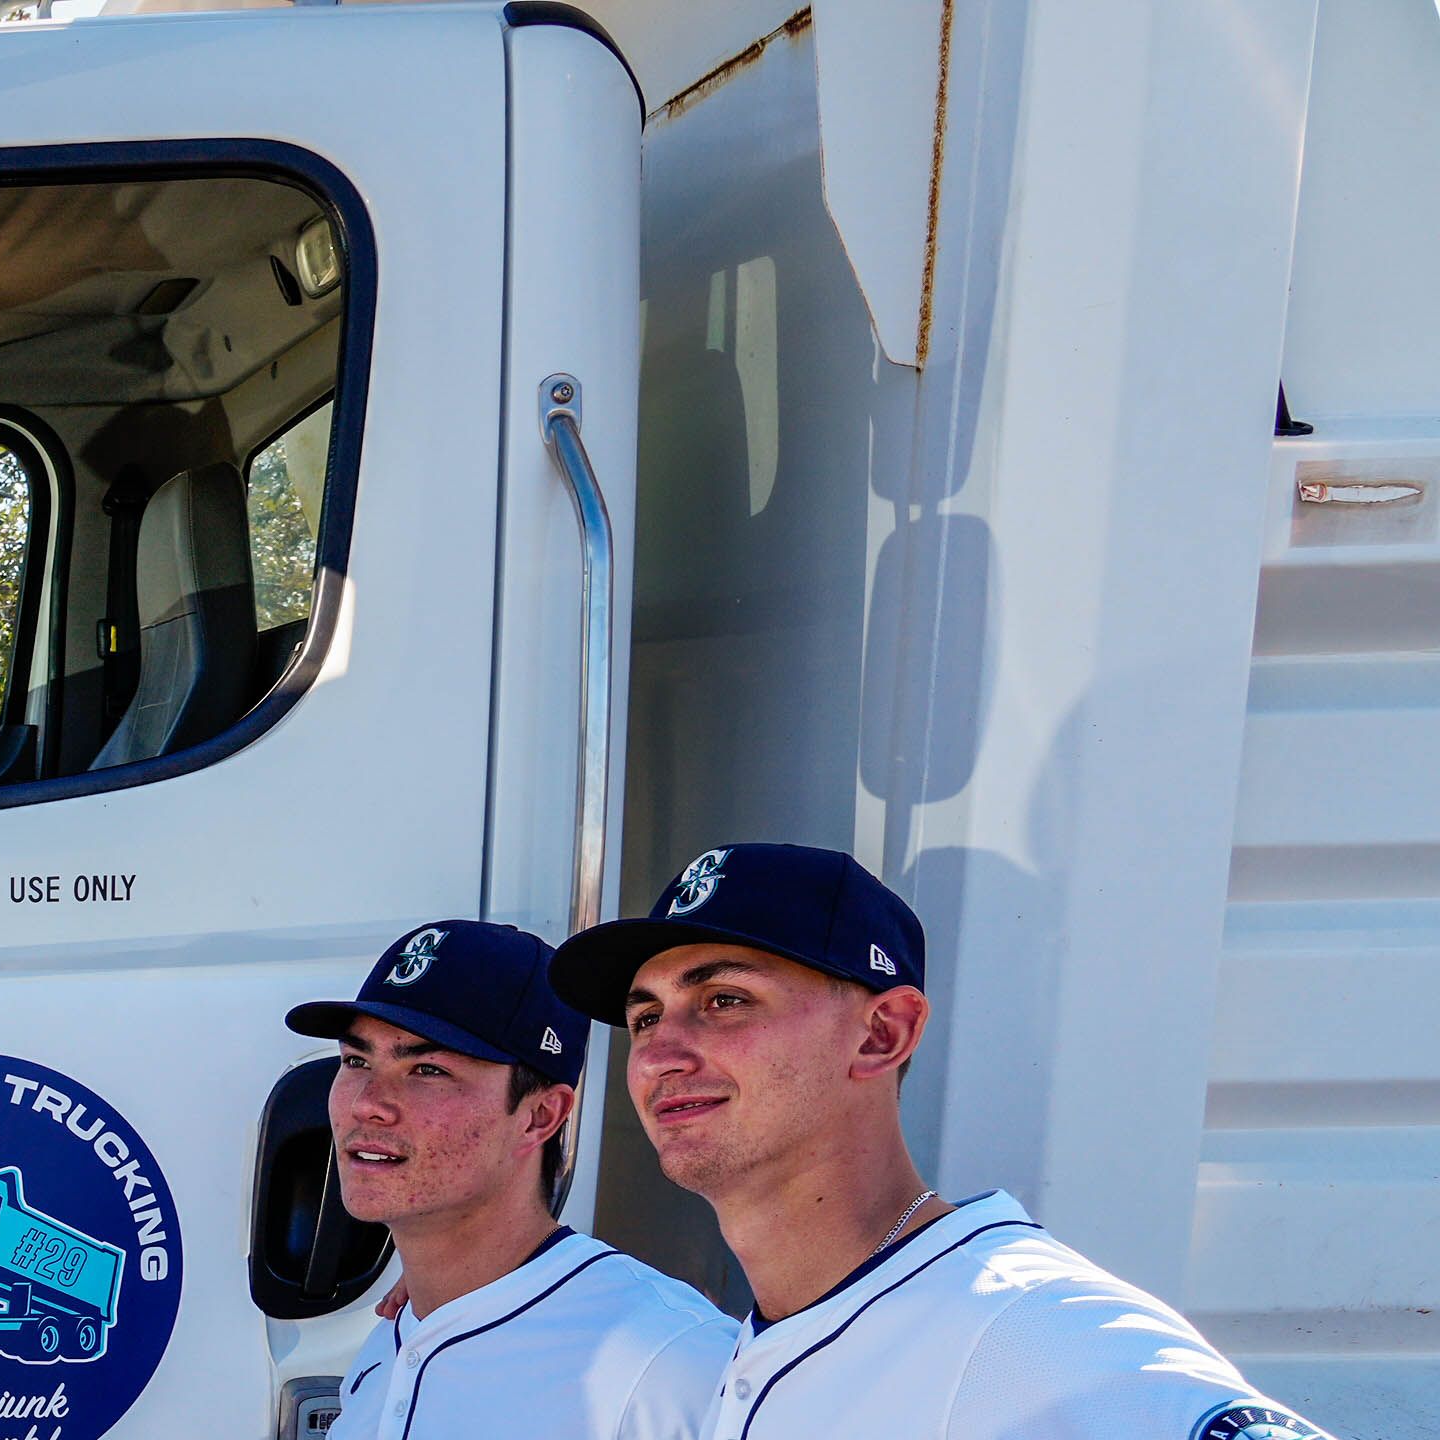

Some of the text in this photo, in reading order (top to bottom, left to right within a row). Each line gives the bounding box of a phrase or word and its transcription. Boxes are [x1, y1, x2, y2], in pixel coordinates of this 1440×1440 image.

[9, 875, 61, 903] USE
[73, 874, 137, 902] ONLY
[4, 1073, 169, 1282] TRUCKING
[9, 1228, 87, 1289] #29
